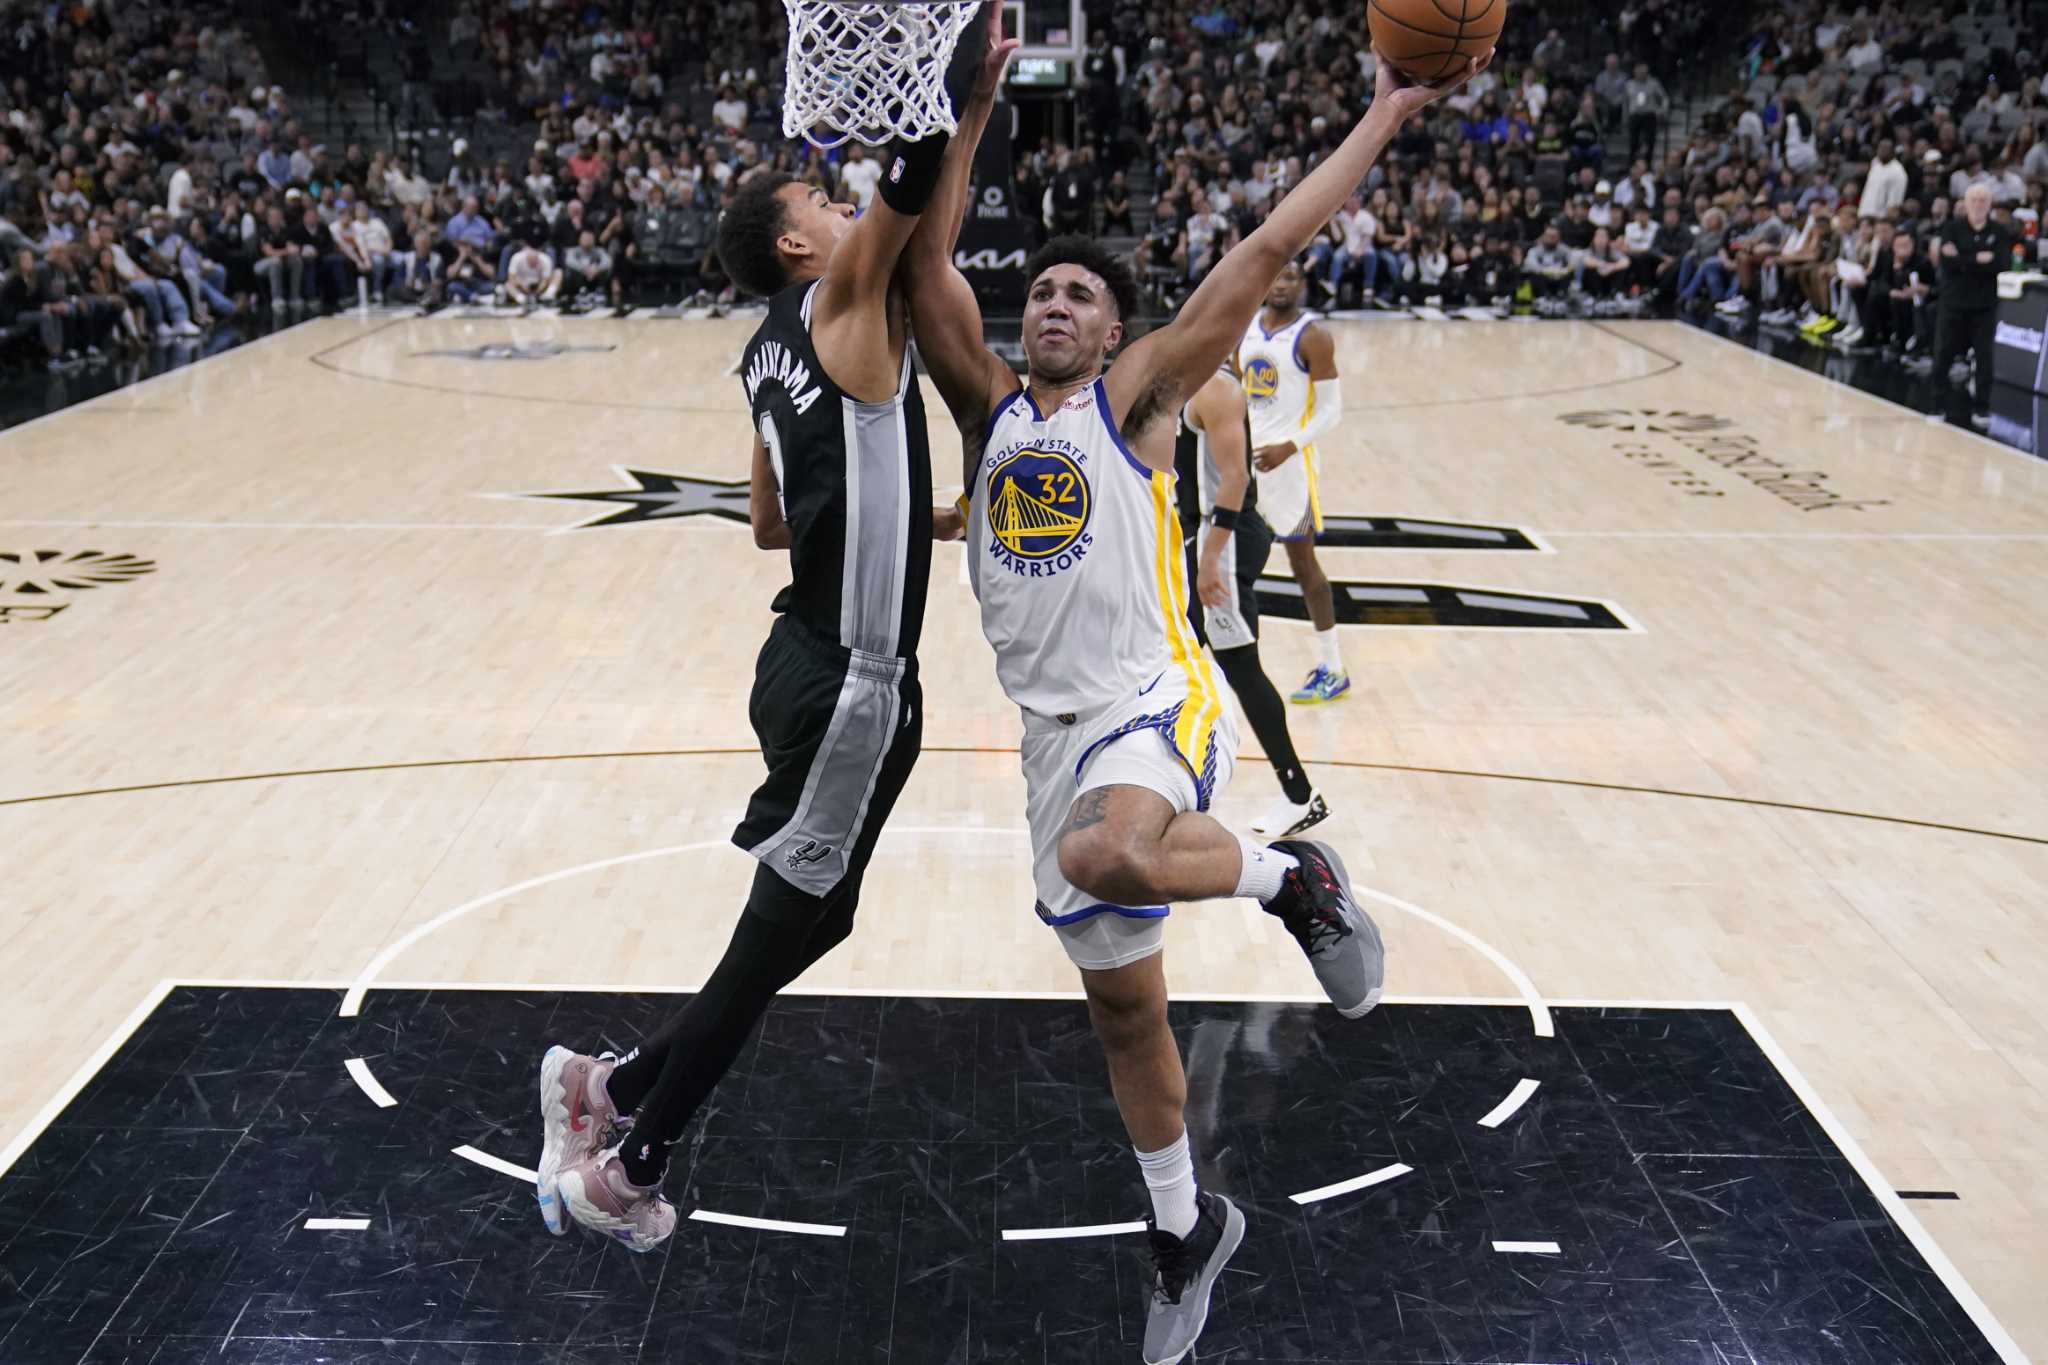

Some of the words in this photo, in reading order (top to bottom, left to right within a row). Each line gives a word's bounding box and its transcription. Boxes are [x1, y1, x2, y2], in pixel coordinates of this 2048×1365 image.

[986, 438, 1045, 469] GOLDN
[1049, 439, 1088, 466] STATE
[1037, 472, 1077, 505] 32
[988, 532, 1094, 578] WARRIORS
